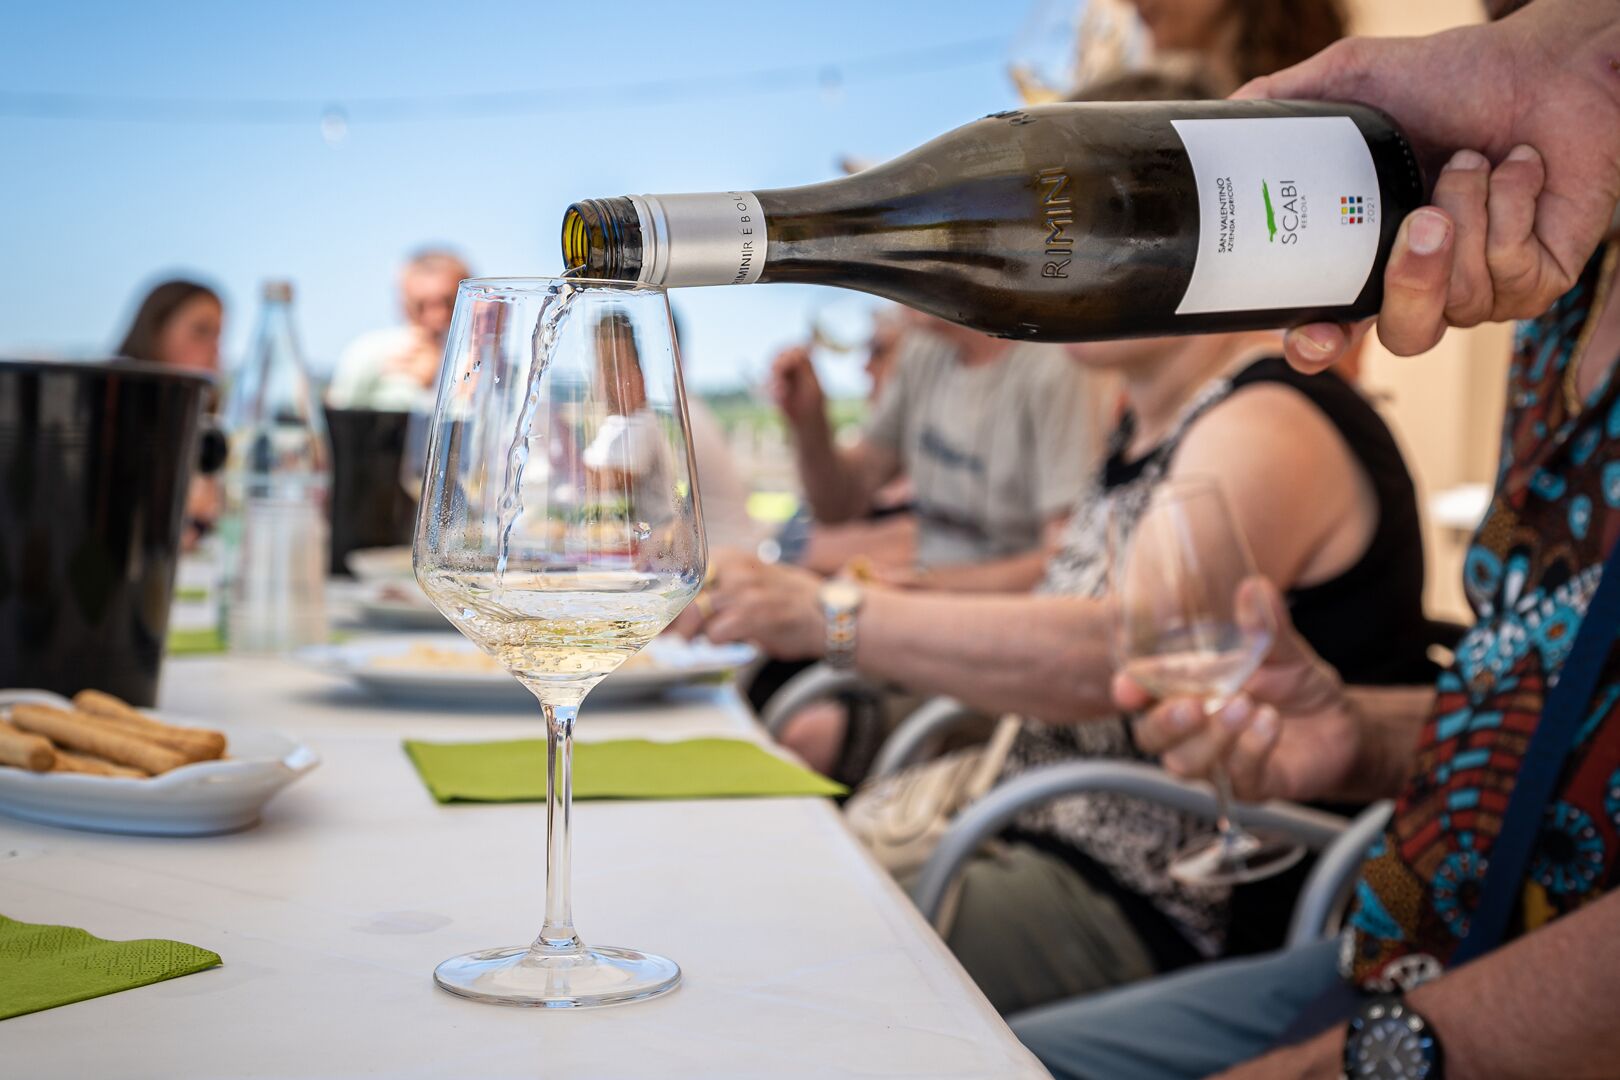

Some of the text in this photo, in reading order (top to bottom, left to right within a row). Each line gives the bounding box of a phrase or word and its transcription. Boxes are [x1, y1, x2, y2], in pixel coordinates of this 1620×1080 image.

[729, 191, 753, 249] REBOL
[1041, 167, 1073, 278] RIMINI
[1216, 178, 1228, 253] SAN VALENTINO
[1226, 177, 1236, 252] AZIENDA AGRICOLA
[1280, 180, 1299, 245] SCABI
[1367, 196, 1376, 224] 2021
